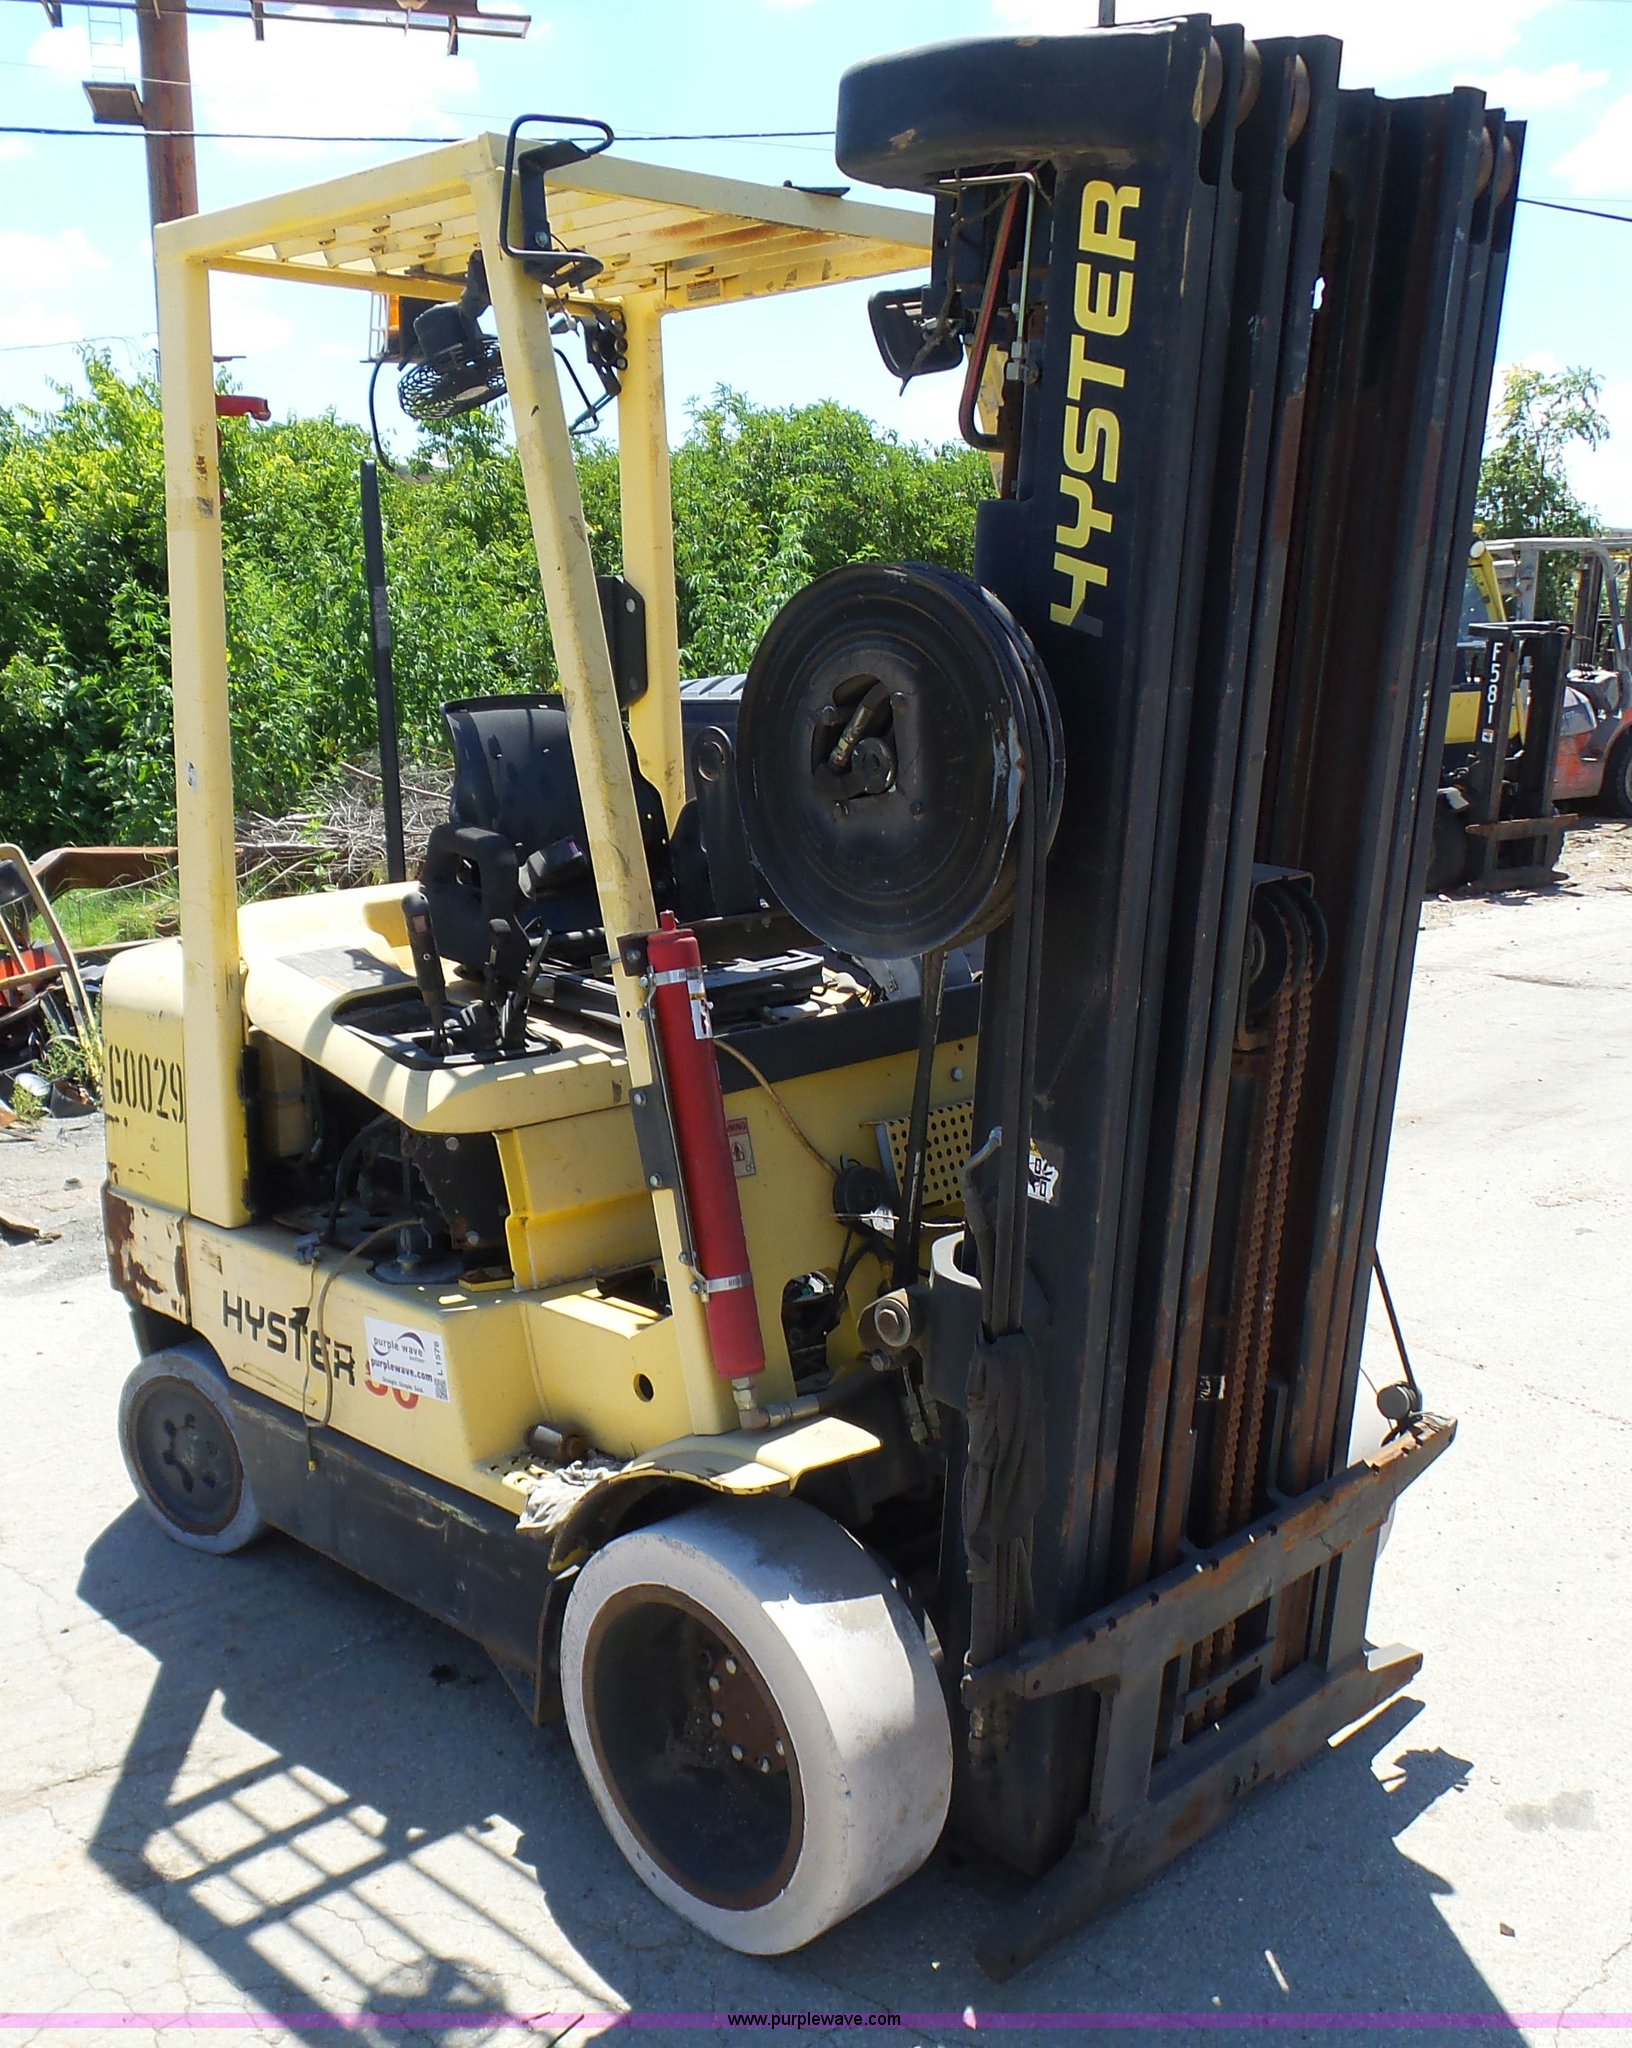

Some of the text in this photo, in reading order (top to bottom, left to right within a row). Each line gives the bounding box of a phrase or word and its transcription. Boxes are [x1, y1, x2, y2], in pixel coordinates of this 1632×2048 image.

[1049, 179, 1141, 638] HYSTER
[1487, 642, 1504, 725] F581
[108, 1044, 184, 1125] G0029
[222, 1289, 356, 1387] HYSTER
[370, 1358, 433, 1382] purplewave.com
[373, 1337, 424, 1358] purple wave
